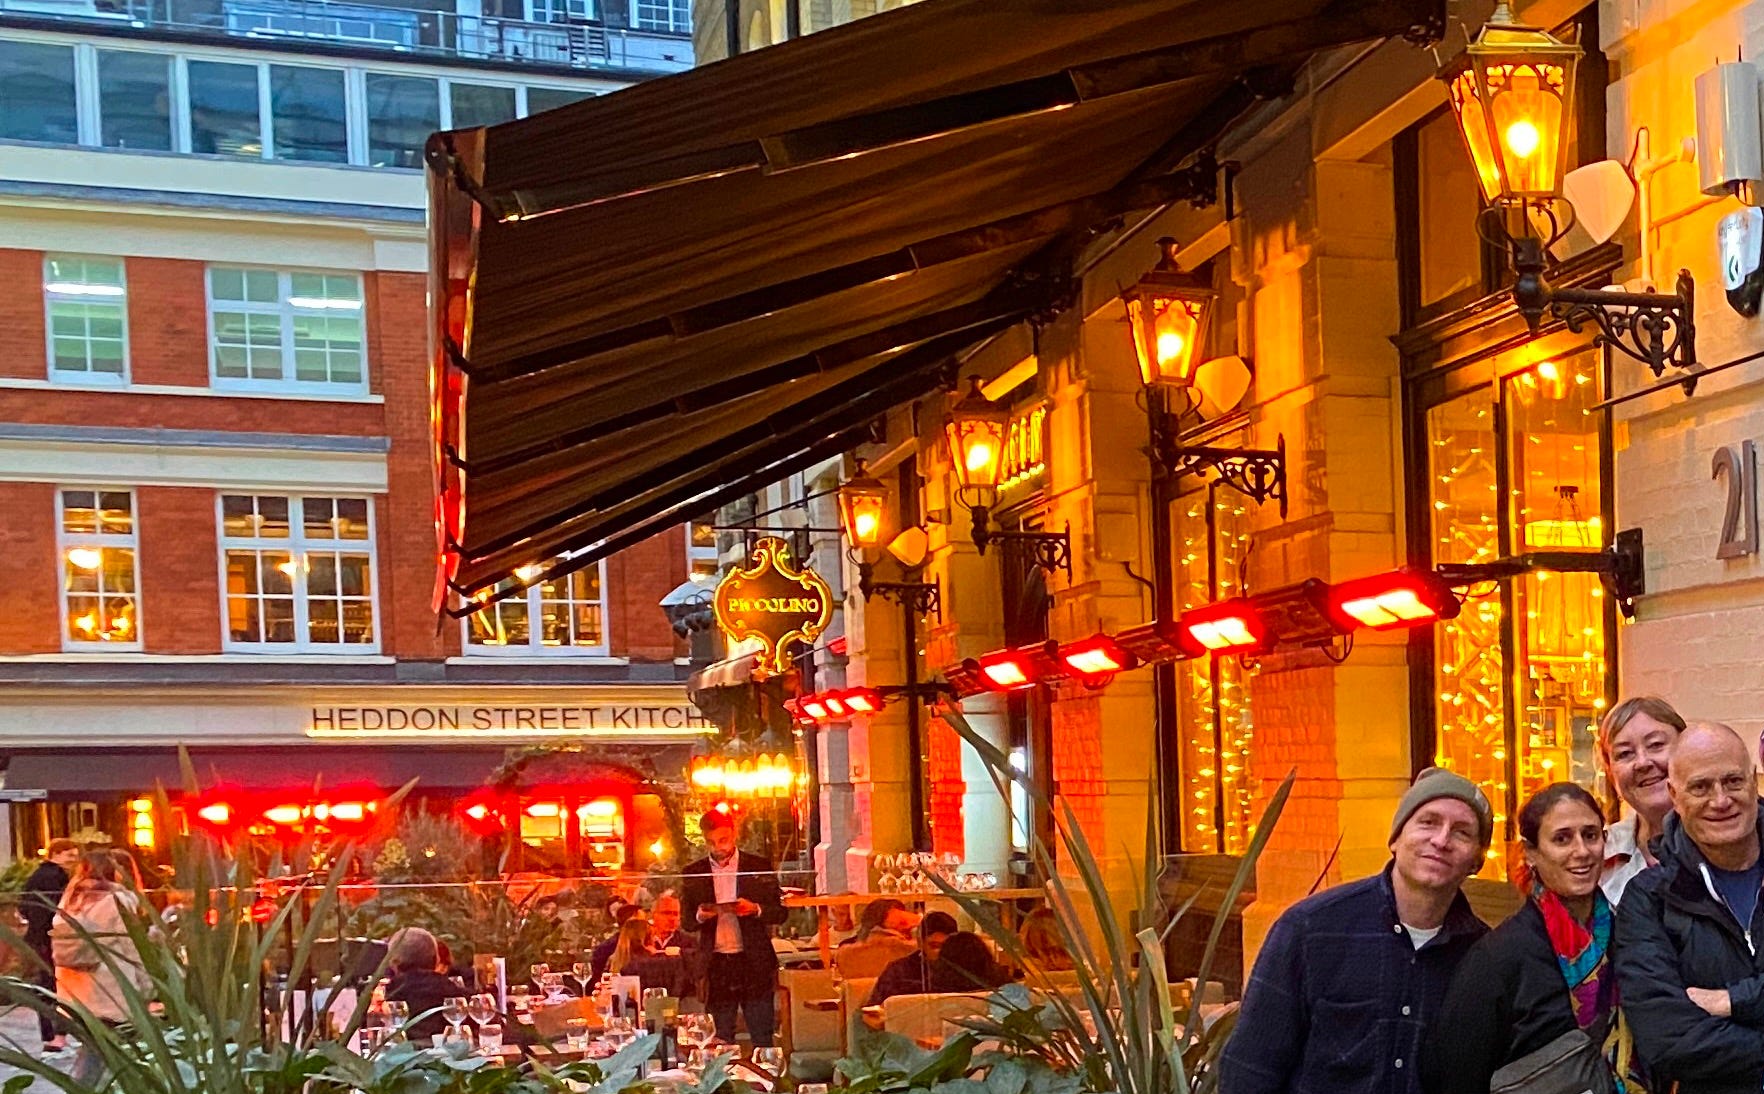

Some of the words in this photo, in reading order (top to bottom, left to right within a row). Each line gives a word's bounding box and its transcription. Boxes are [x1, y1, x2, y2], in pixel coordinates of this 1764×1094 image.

[1711, 439, 1759, 560] 21
[728, 598, 819, 612] PICCOLINO
[312, 707, 460, 731] HEDDON
[472, 707, 601, 731] STREET
[612, 707, 716, 729] KITCH
